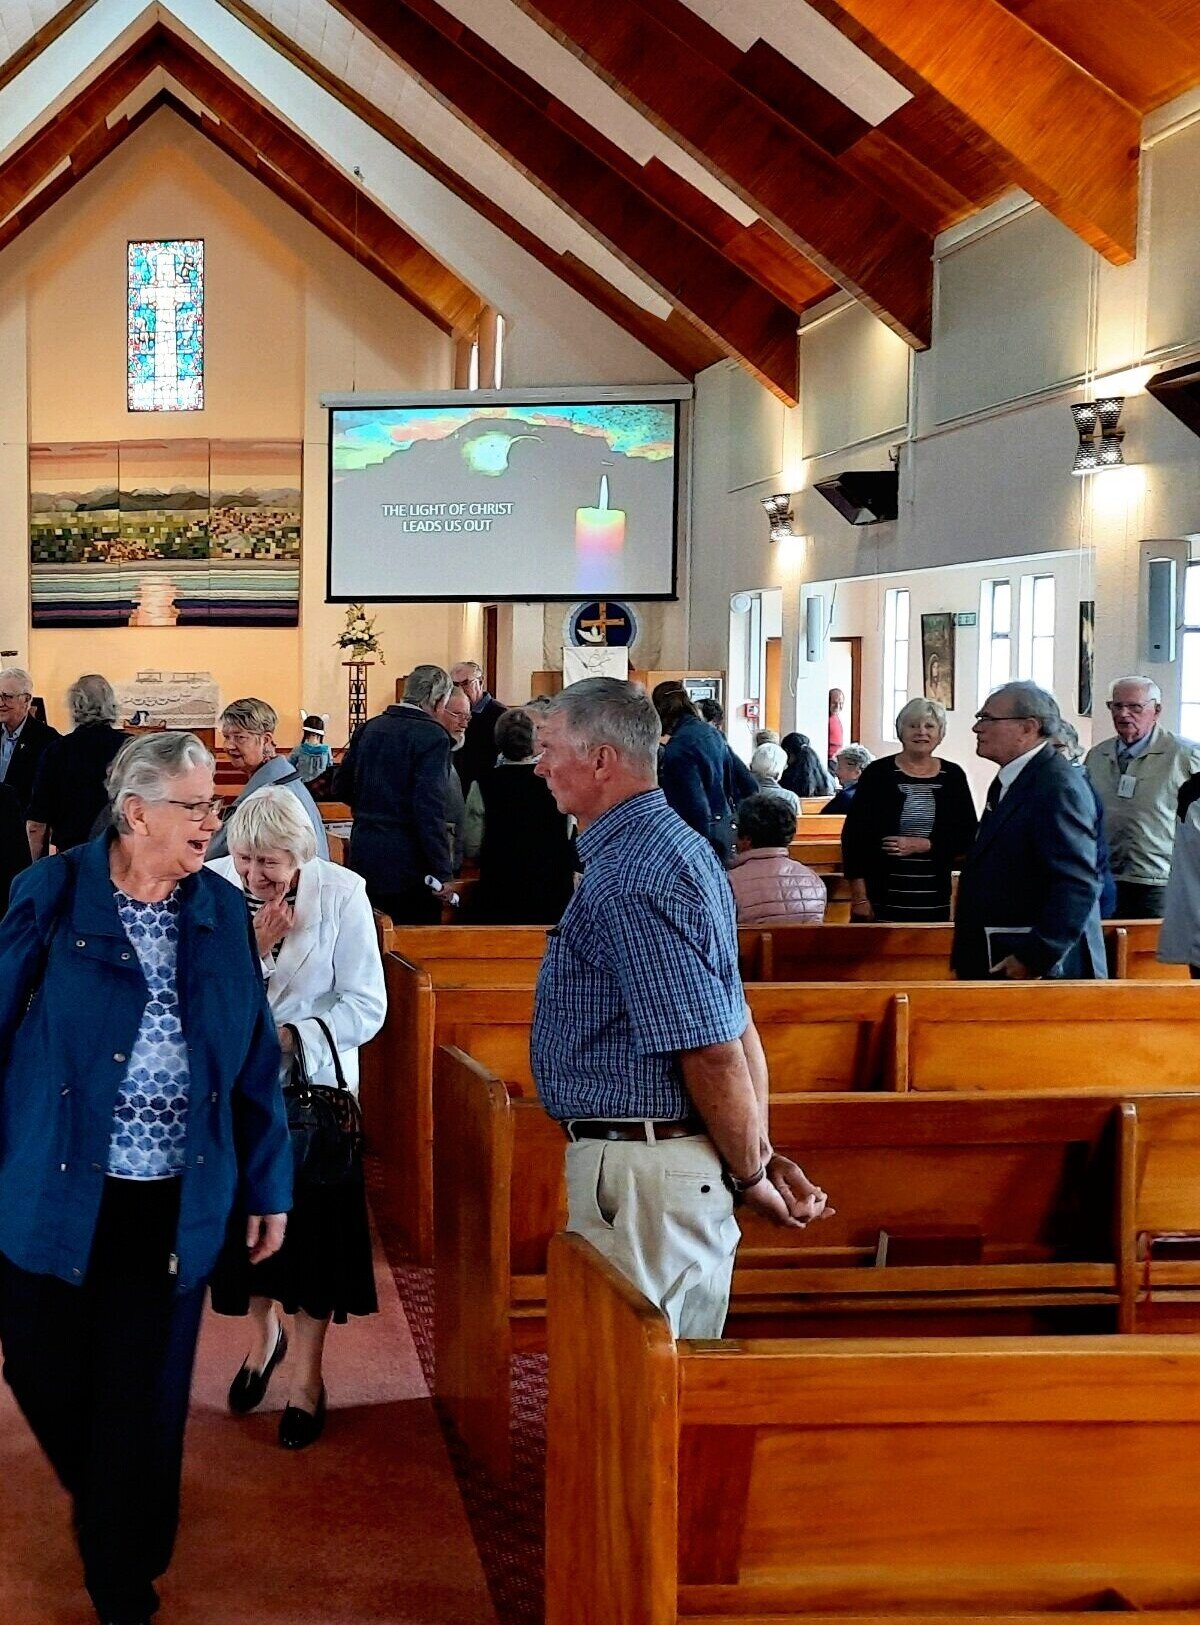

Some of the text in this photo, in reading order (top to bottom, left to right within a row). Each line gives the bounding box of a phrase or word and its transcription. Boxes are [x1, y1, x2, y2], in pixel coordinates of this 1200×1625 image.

[381, 502, 514, 516] THE LIGHT OF CHRIST
[403, 519, 493, 532] LEADS US OUT
